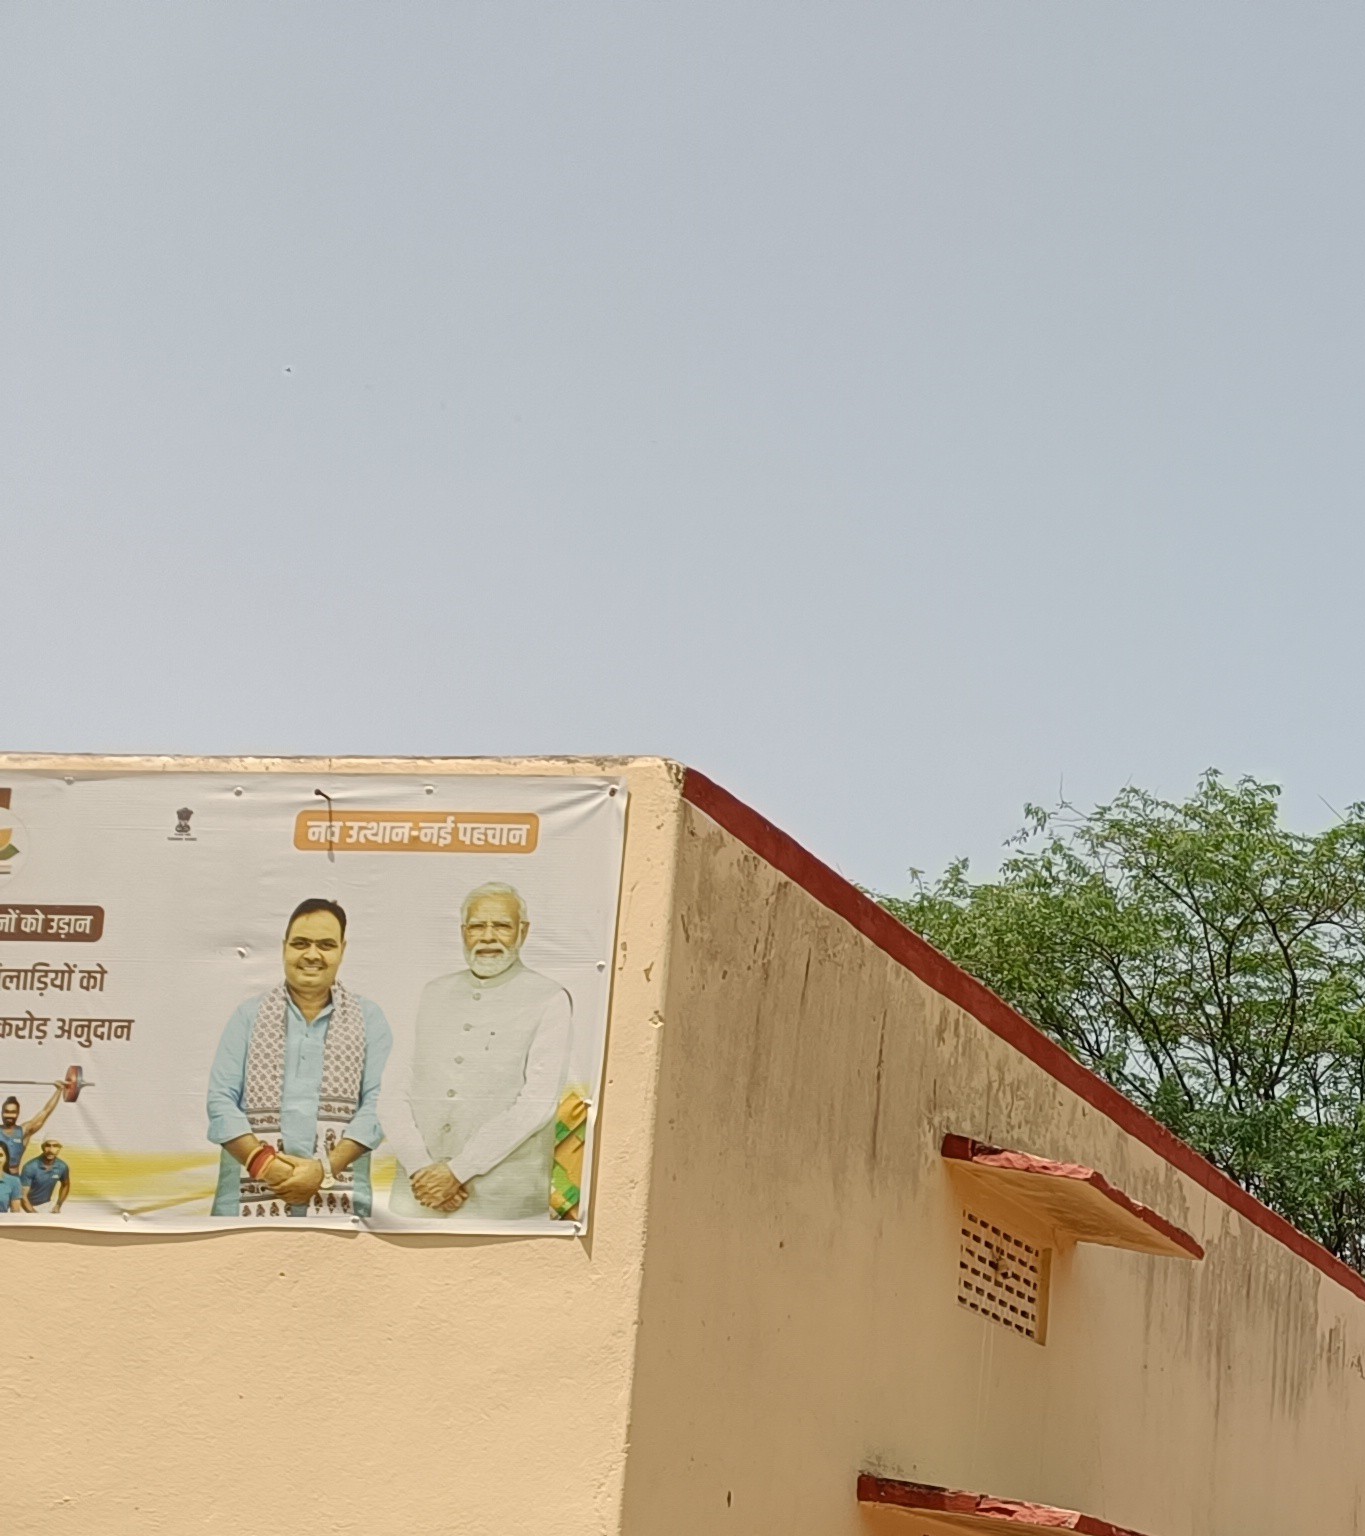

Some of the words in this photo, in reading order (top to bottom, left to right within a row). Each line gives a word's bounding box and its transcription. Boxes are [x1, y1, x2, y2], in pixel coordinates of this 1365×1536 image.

[306, 820, 343, 844] नव
[345, 816, 455, 847] उत्थान-नई
[457, 822, 530, 846] पहचान
[21, 908, 45, 934] को
[47, 913, 94, 939] उड़ान
[0, 961, 77, 997] लाड़ियों
[78, 962, 108, 992] को
[0, 1010, 51, 1046] करोड़
[54, 1017, 135, 1049] अनुदान
